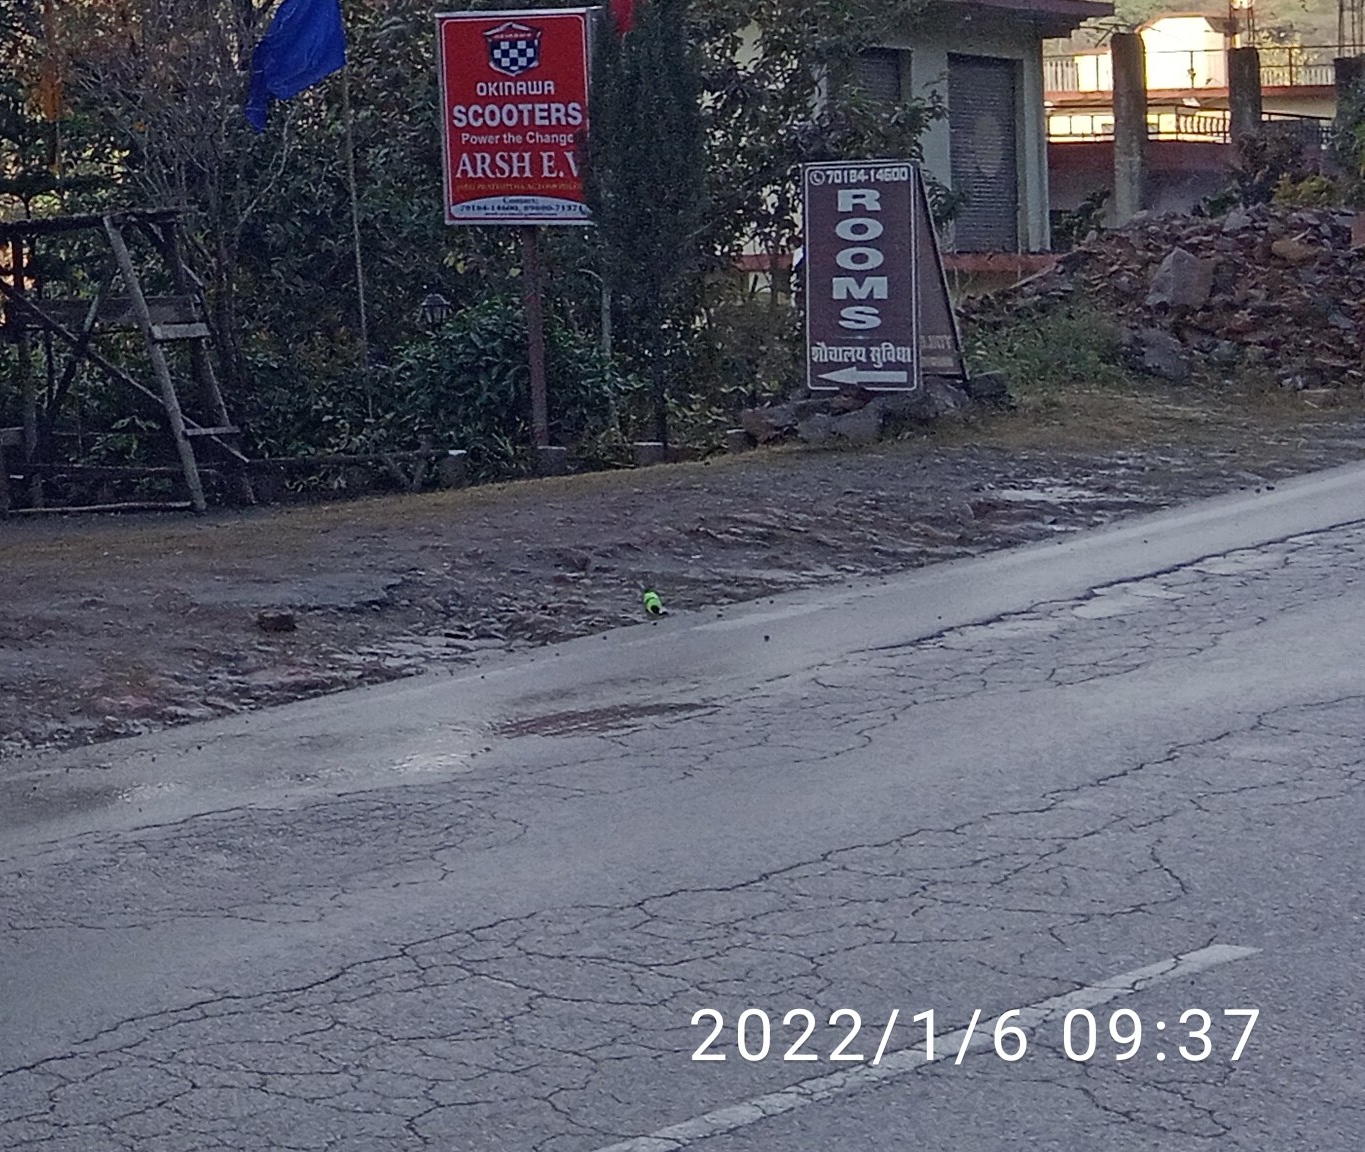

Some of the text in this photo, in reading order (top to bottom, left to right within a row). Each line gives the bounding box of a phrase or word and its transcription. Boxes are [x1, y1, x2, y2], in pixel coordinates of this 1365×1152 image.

[476, 80, 555, 97] OKINAWA
[453, 102, 583, 127] SCOOTERS
[461, 133, 500, 145] Power
[503, 132, 522, 144] the
[455, 151, 533, 179] ARSH
[832, 188, 889, 330] ROOMS
